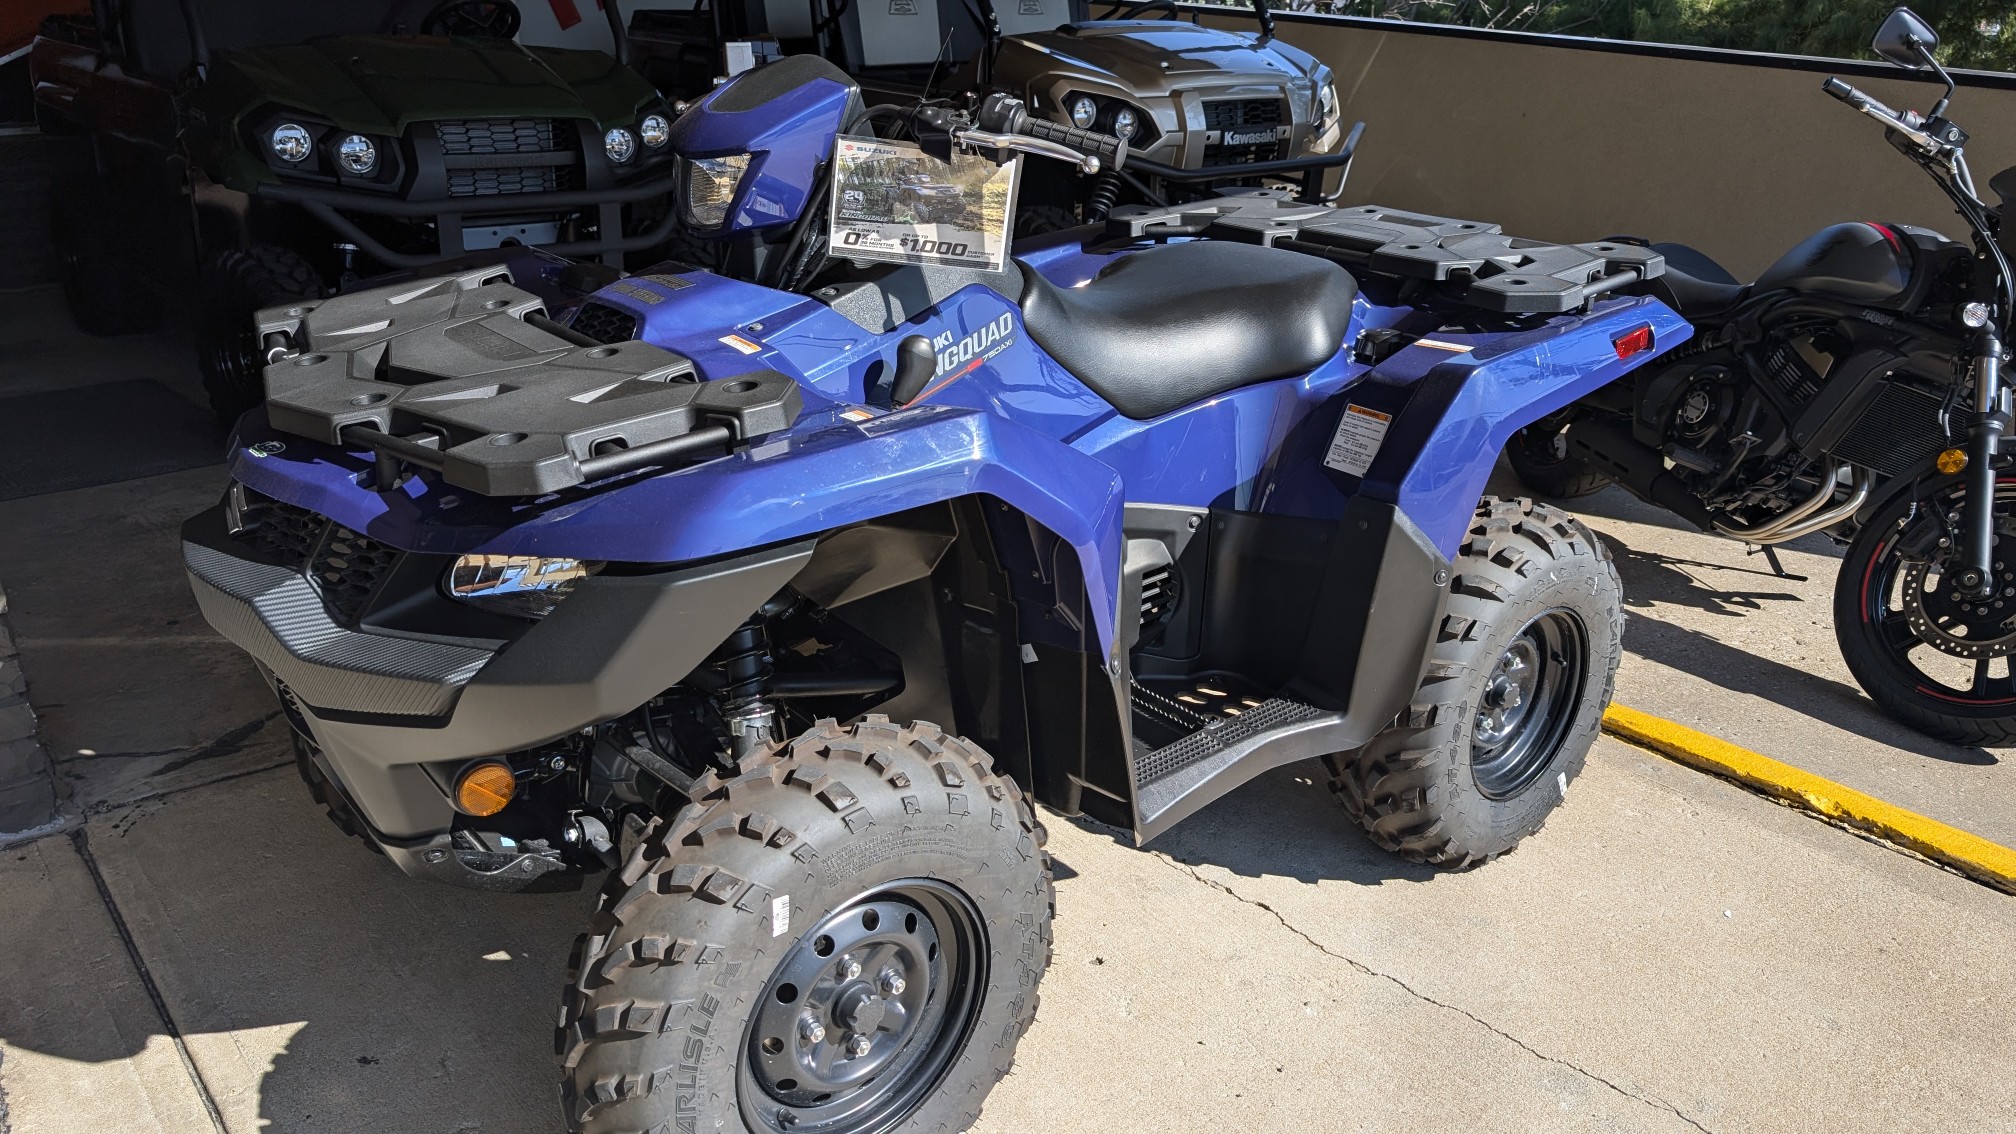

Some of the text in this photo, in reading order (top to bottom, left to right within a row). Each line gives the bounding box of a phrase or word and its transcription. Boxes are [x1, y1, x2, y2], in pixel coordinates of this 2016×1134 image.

[1224, 128, 1277, 146] Kawasaki
[856, 146, 898, 156] SUZUKI
[843, 190, 865, 201] 24
[899, 237, 968, 257] $1,000
[933, 330, 954, 352] UKI
[935, 312, 1013, 376] NGQUAD
[1598, 618, 1618, 712] CARLISLE
[675, 991, 720, 1134] ARLISLE
